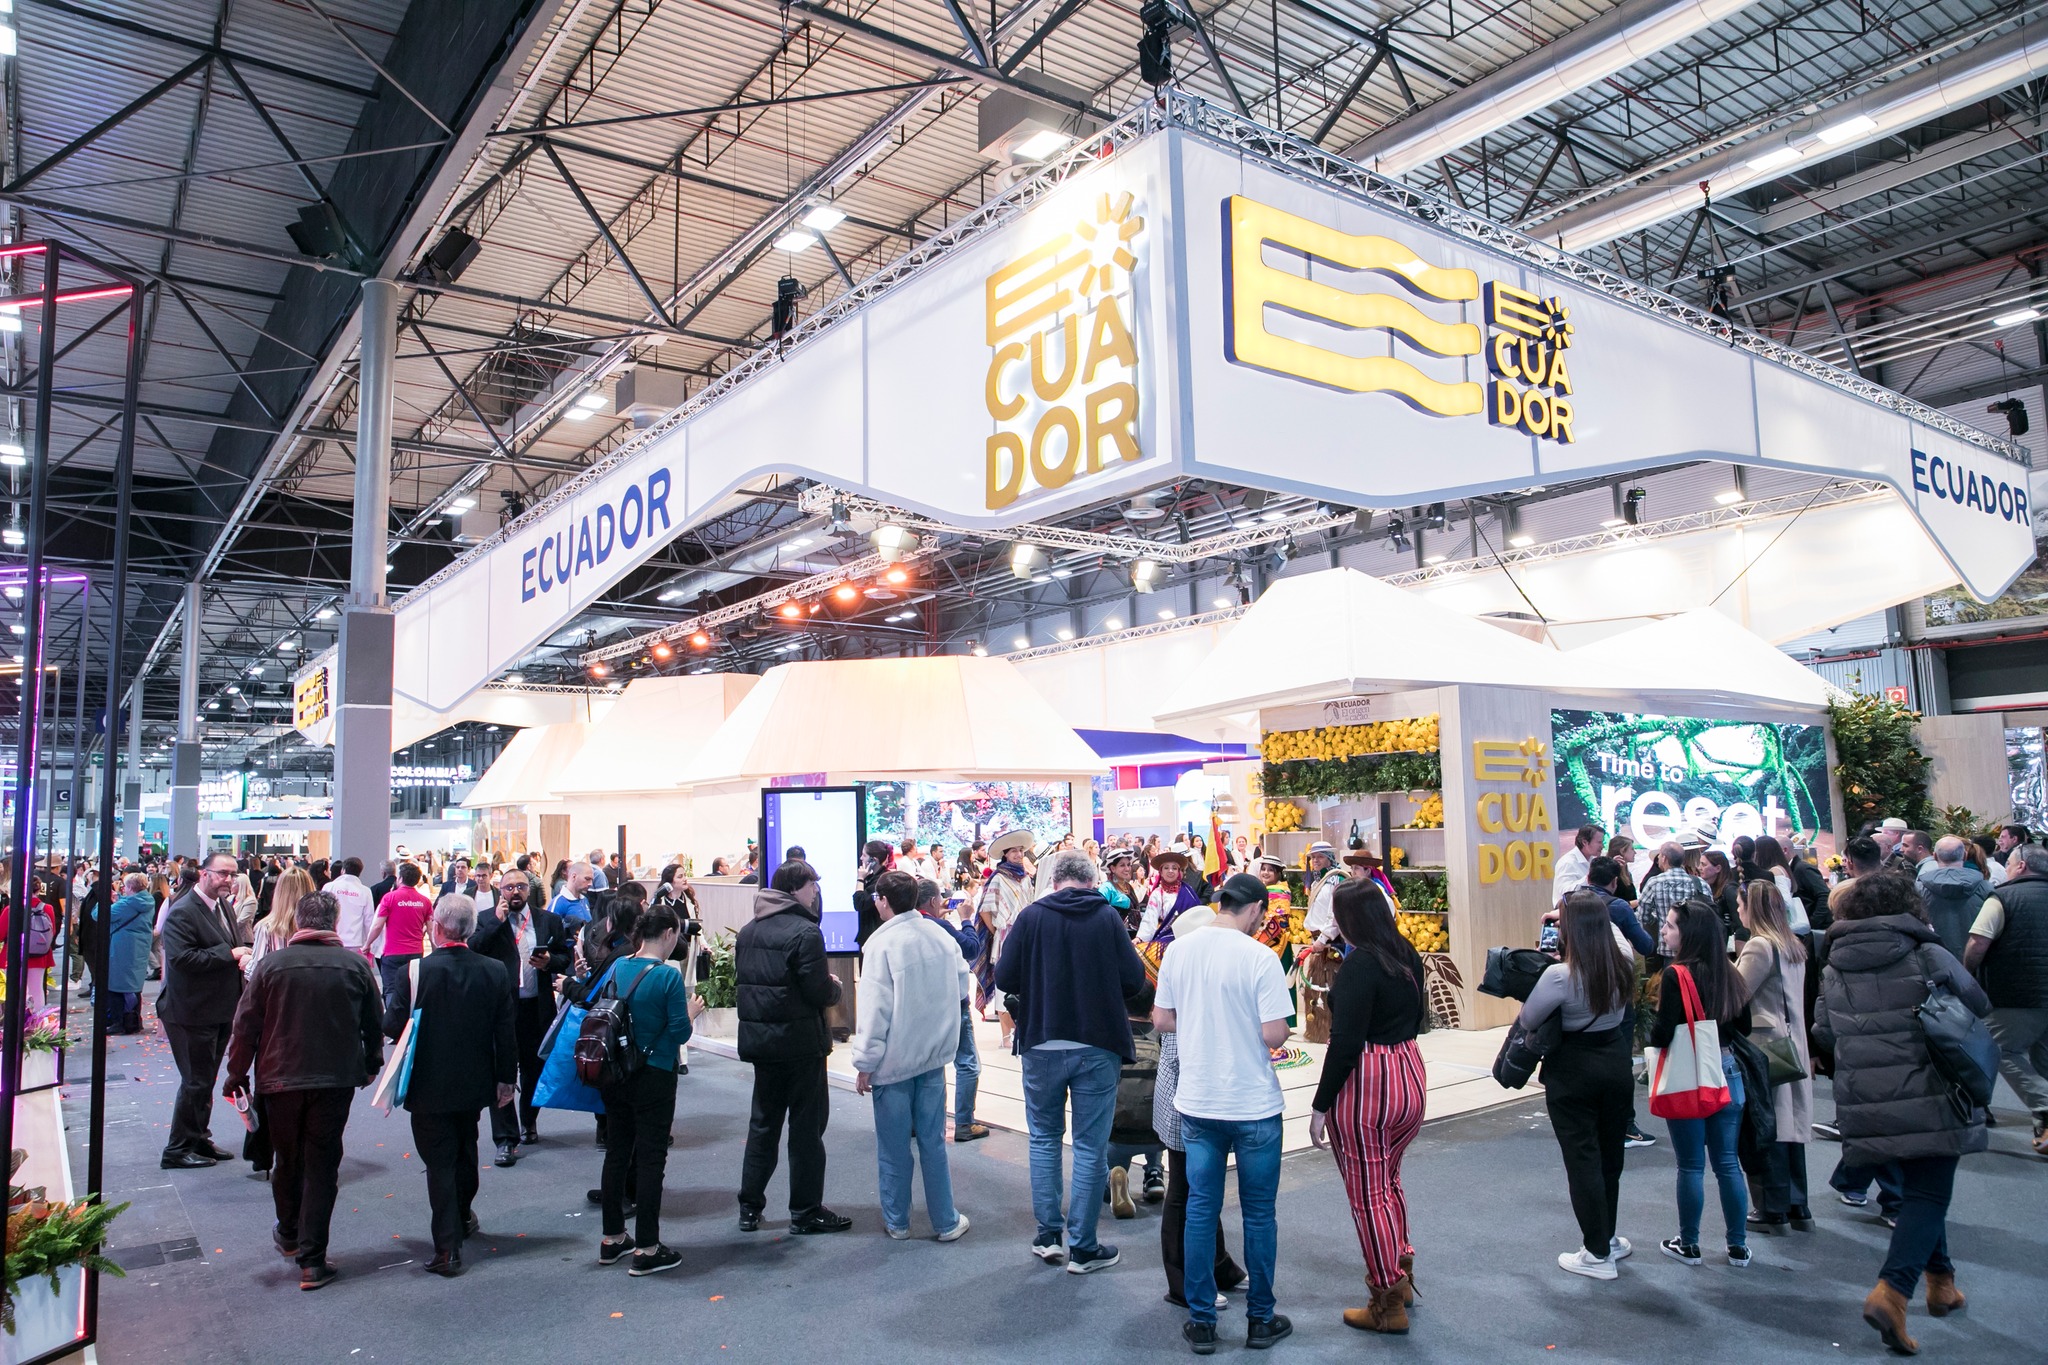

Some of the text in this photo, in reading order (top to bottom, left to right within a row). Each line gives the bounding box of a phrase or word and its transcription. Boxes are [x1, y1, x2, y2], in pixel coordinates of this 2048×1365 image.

[985, 294, 1139, 422] CUA
[1486, 332, 1573, 398] CUA
[1488, 380, 1575, 444] DOR
[986, 381, 1141, 510] DOR
[1910, 447, 2029, 527] ECUADOR
[522, 467, 671, 604] ECUADOR
[1341, 699, 1370, 709] ECUADOR
[390, 766, 457, 778] COLOMBIA
[1597, 751, 1684, 783] Time to
[60, 792, 68, 800] C
[1477, 792, 1552, 833] CUA
[1478, 840, 1554, 884] DOR
[336, 889, 360, 898] civitatis
[397, 900, 424, 908] civitatis
